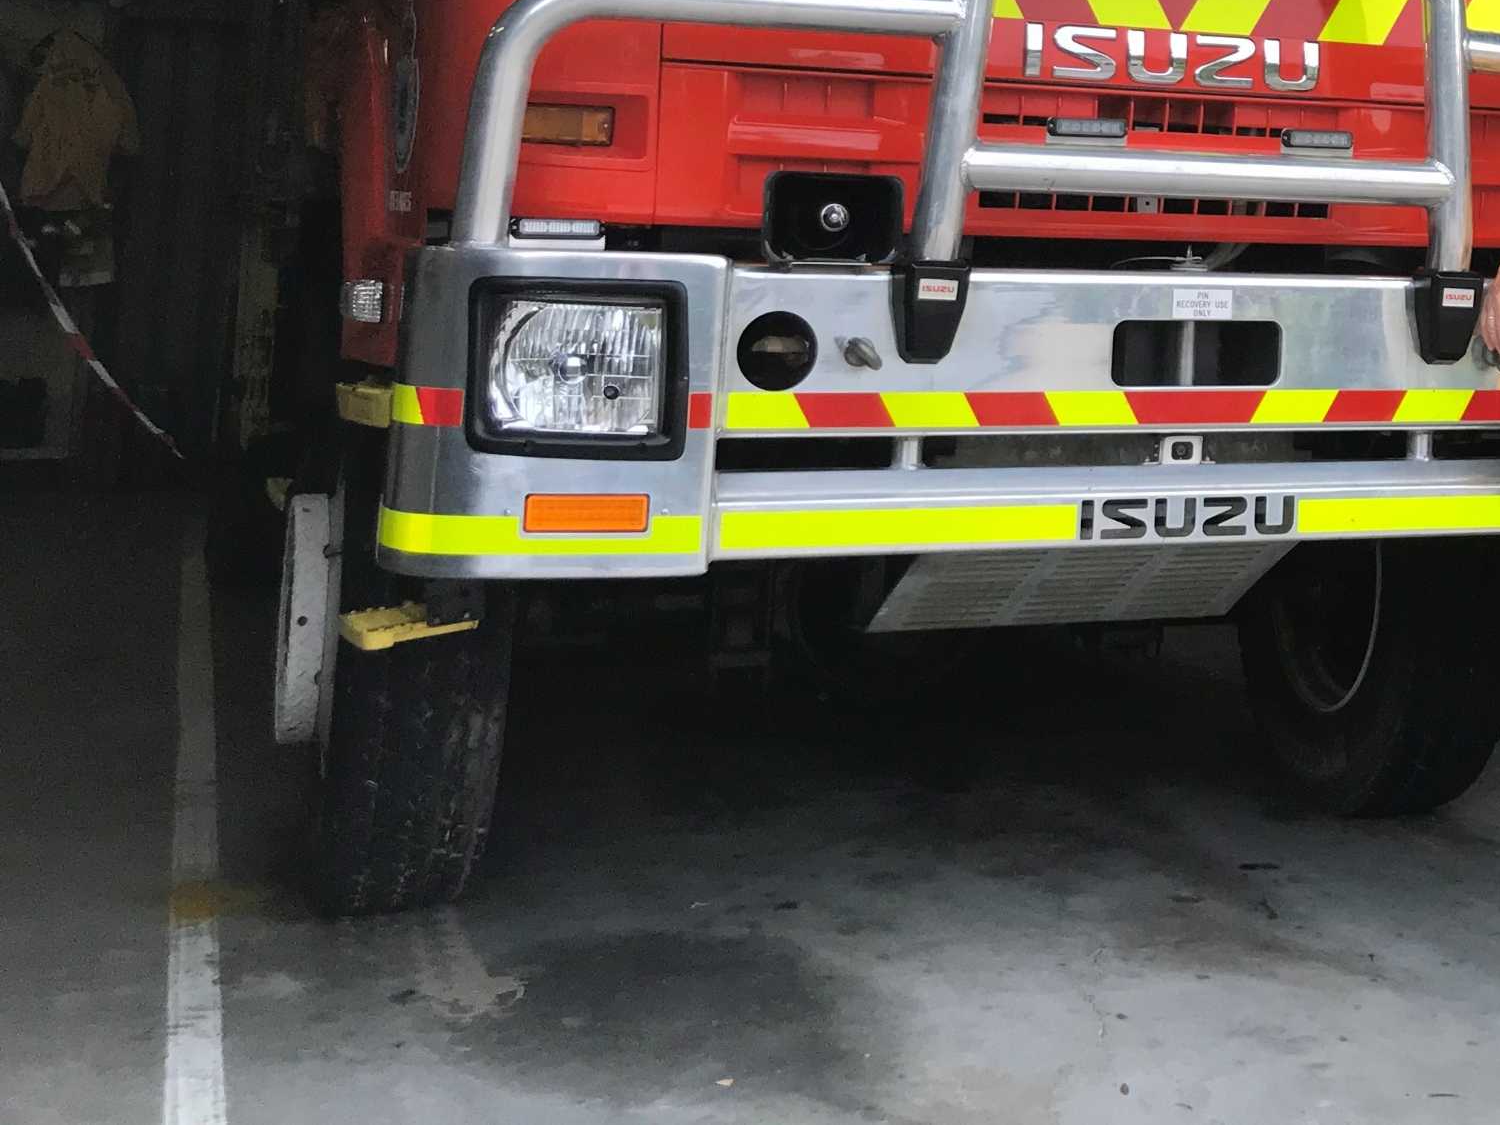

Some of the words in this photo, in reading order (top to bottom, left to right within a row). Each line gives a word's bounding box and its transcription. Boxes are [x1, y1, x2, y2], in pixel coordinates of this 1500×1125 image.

[1022, 21, 1320, 92] ISUZU
[922, 285, 955, 293] ISUZU
[1079, 495, 1296, 540] ISUZU
